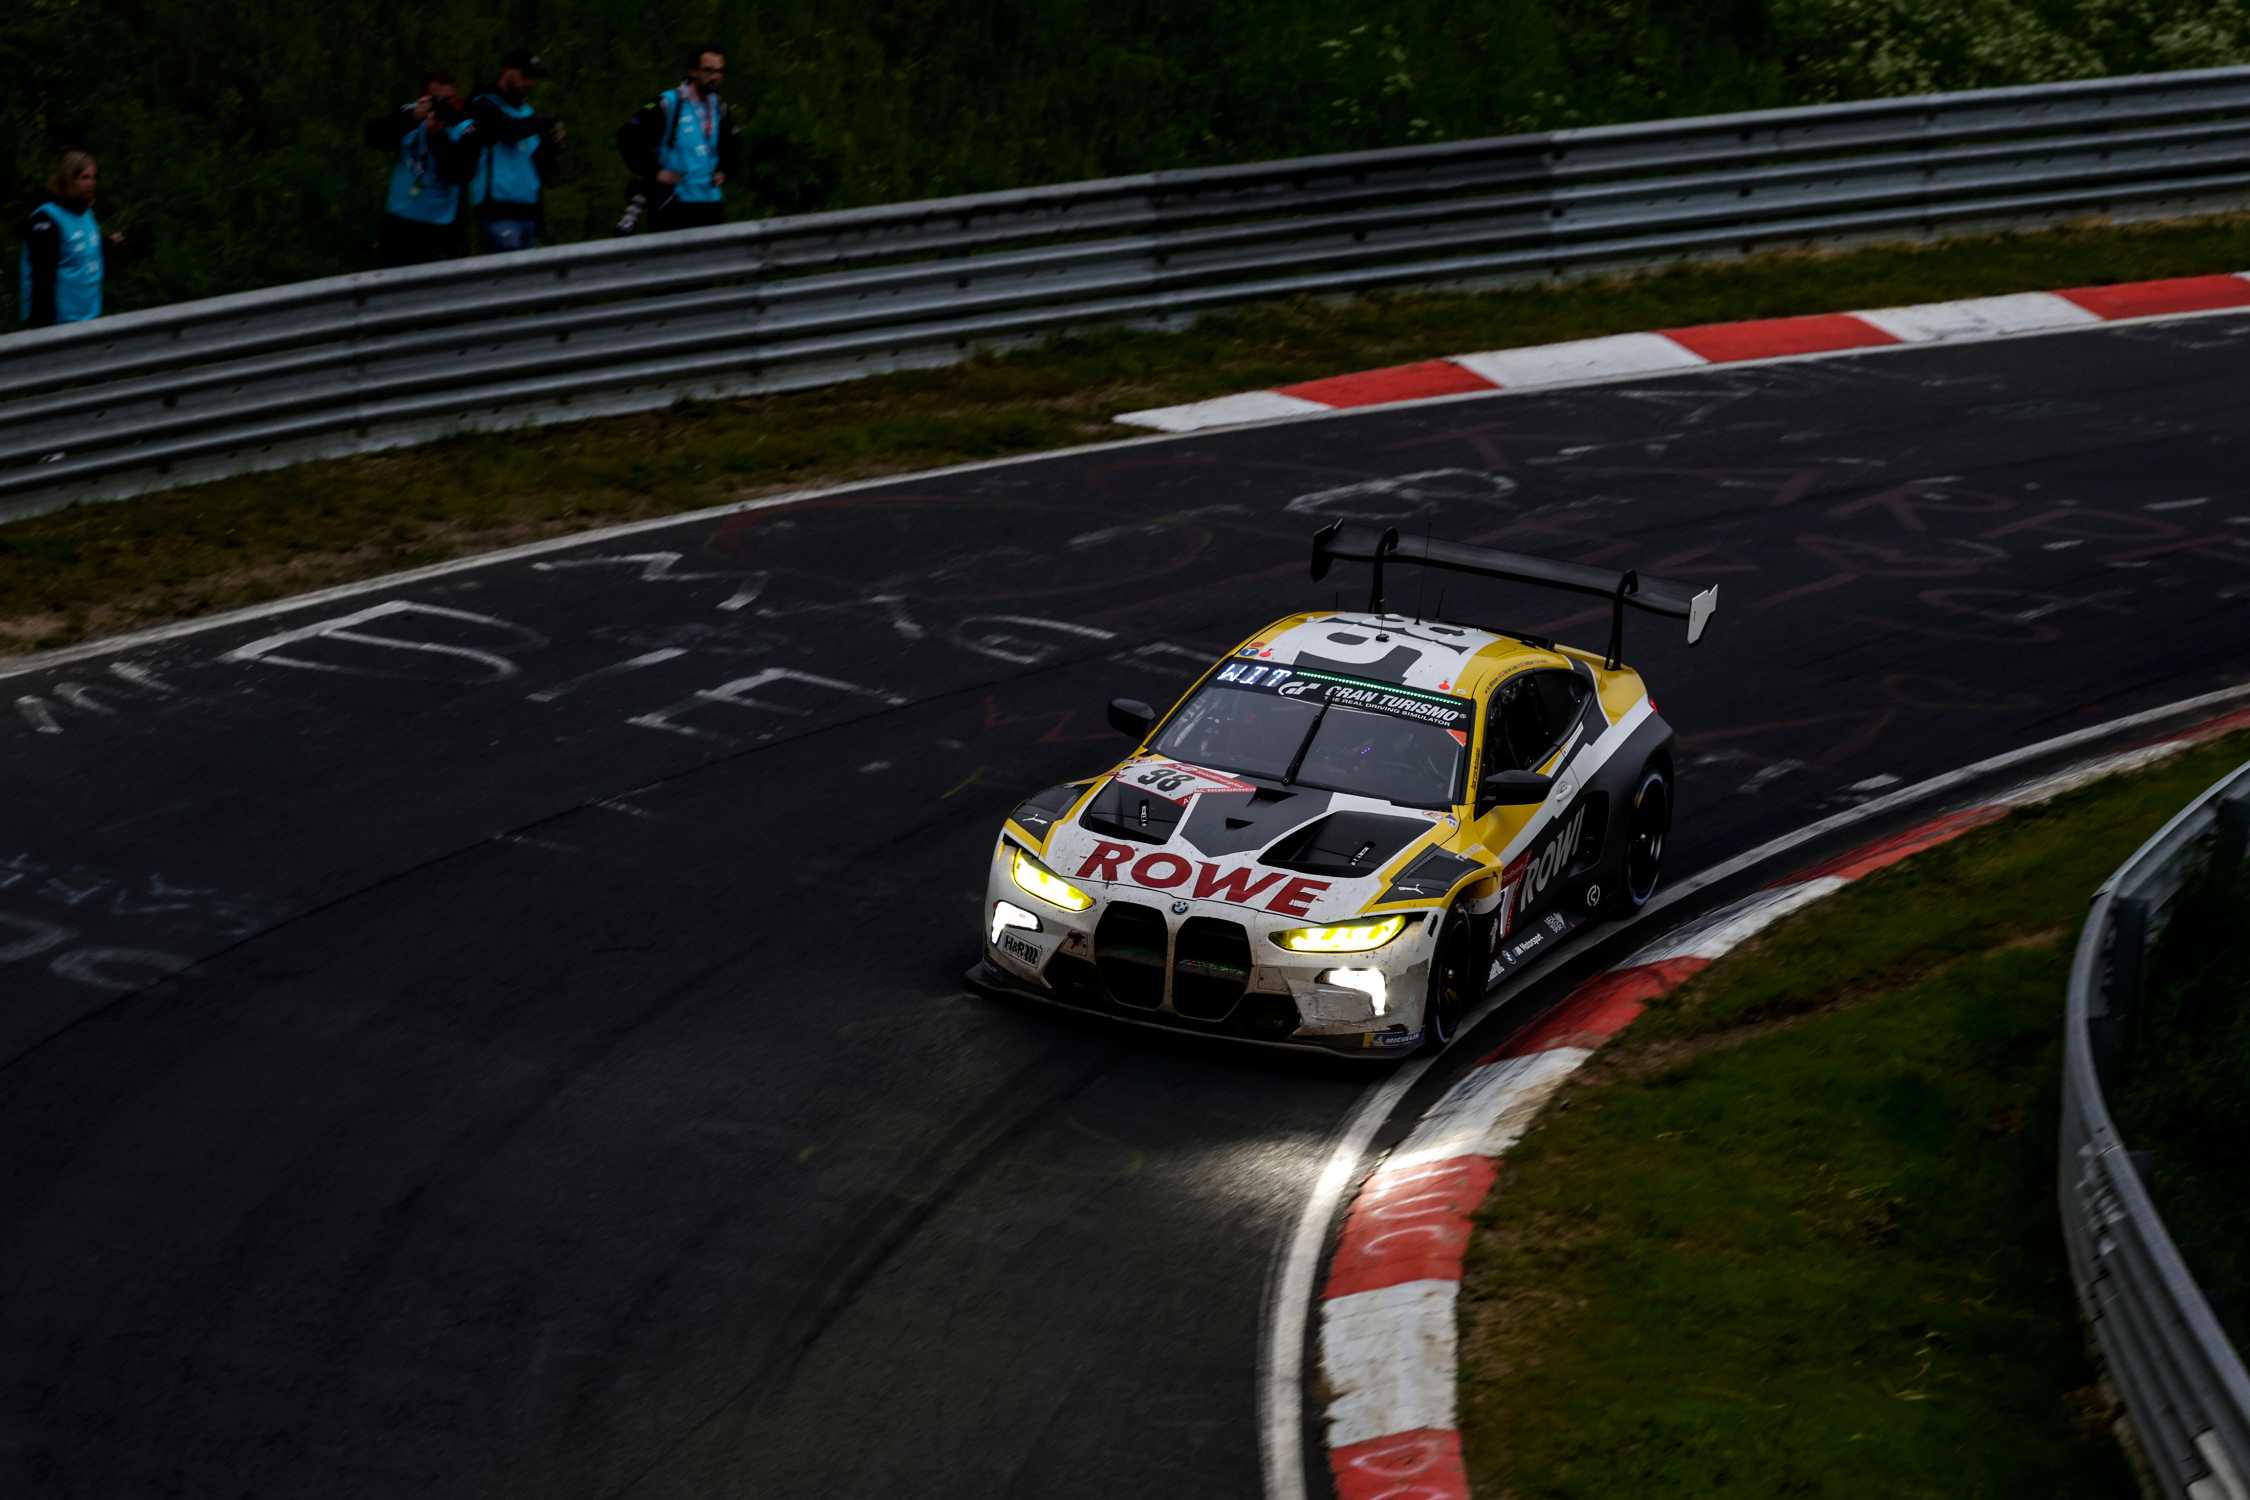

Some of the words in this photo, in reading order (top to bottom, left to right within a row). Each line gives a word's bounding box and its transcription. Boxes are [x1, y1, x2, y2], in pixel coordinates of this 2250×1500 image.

[1325, 685, 1379, 705] GRAN
[1380, 695, 1460, 722] TURISMO
[1340, 698, 1365, 709] REAL
[1365, 702, 1401, 715] DRIVING
[1401, 711, 1451, 727] SIMULATOR
[1137, 768, 1196, 792] 98
[1074, 839, 1333, 917] ROWE
